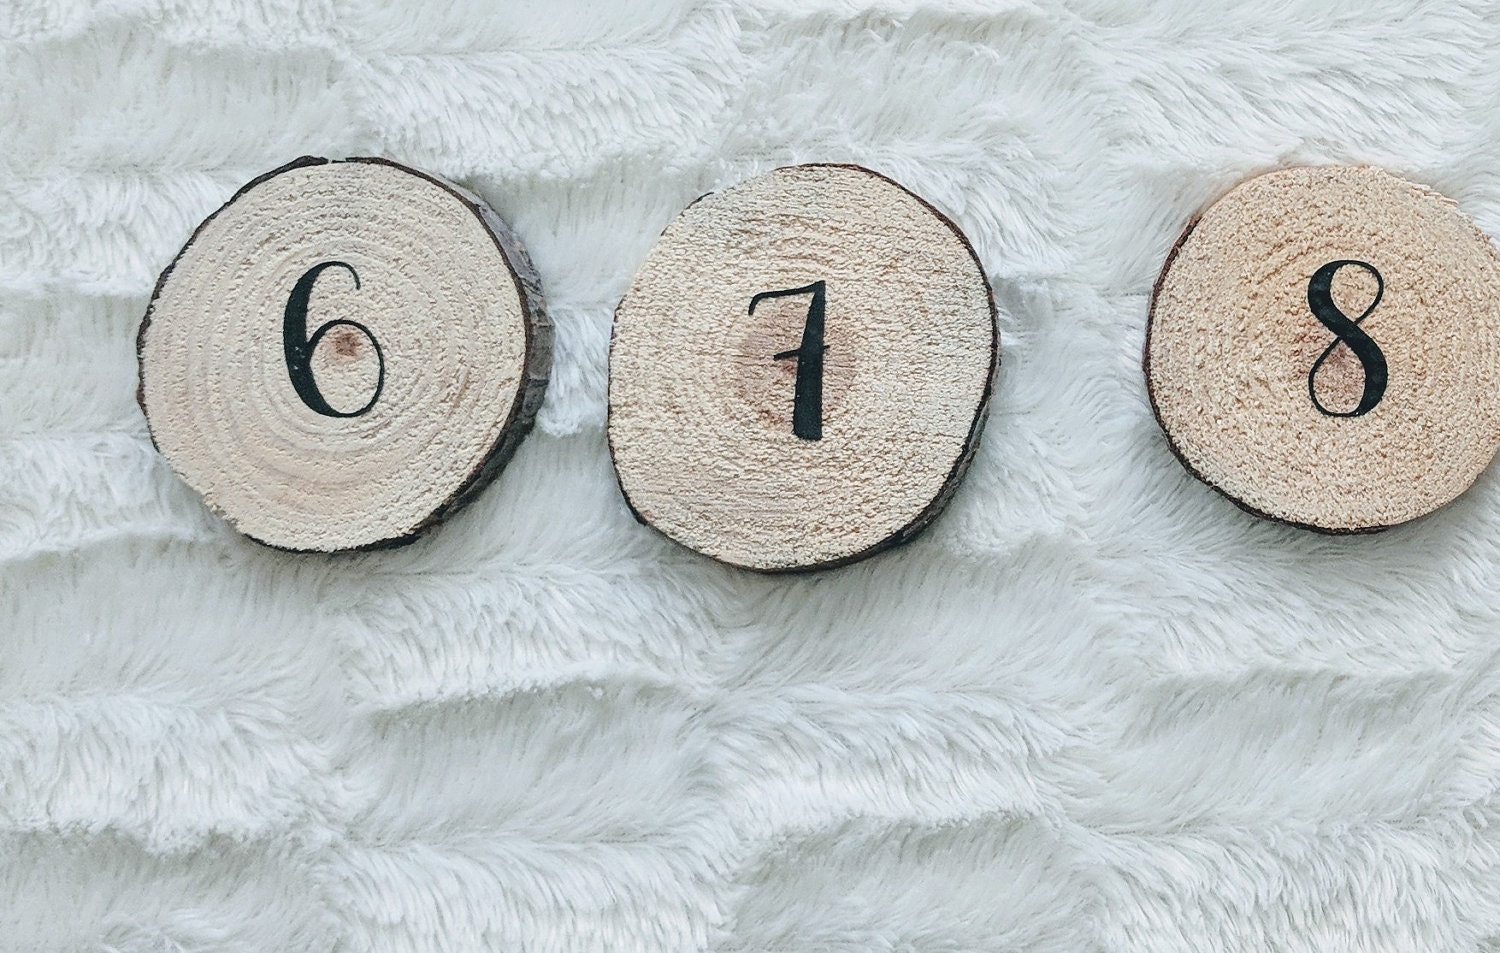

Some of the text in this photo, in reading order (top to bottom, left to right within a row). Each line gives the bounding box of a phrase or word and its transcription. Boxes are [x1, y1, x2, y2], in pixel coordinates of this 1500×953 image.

[282, 260, 386, 419] 6
[747, 279, 831, 444] 7
[1307, 259, 1389, 421] 8
